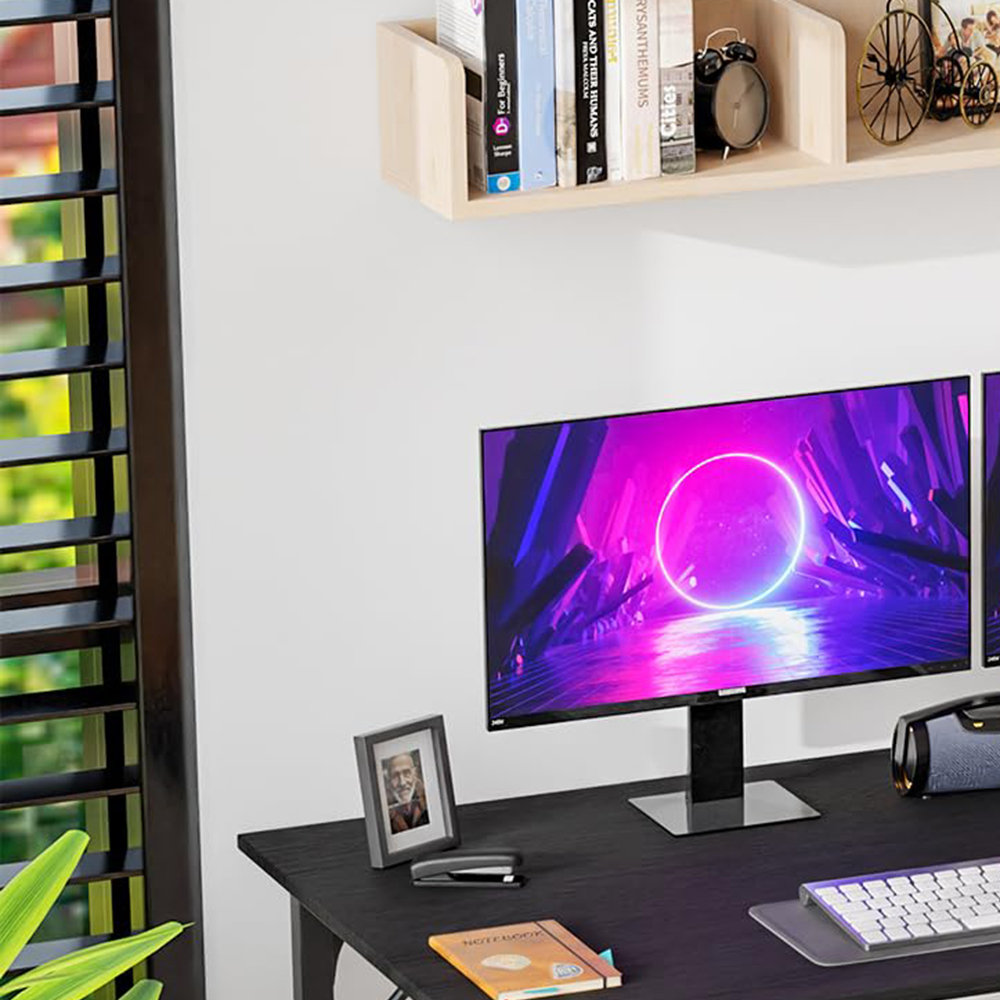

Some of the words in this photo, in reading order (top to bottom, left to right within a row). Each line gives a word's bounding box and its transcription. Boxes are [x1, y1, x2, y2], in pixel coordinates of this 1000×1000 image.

[587, 0, 598, 28] CATS
[588, 29, 598, 54] AND
[635, 0, 649, 108] RYSANTHEMUMS
[496, 53, 508, 98] Beginners
[589, 55, 599, 89] THEIR
[497, 99, 506, 115] For
[589, 90, 600, 138] HUMANS
[660, 84, 677, 137] Cities
